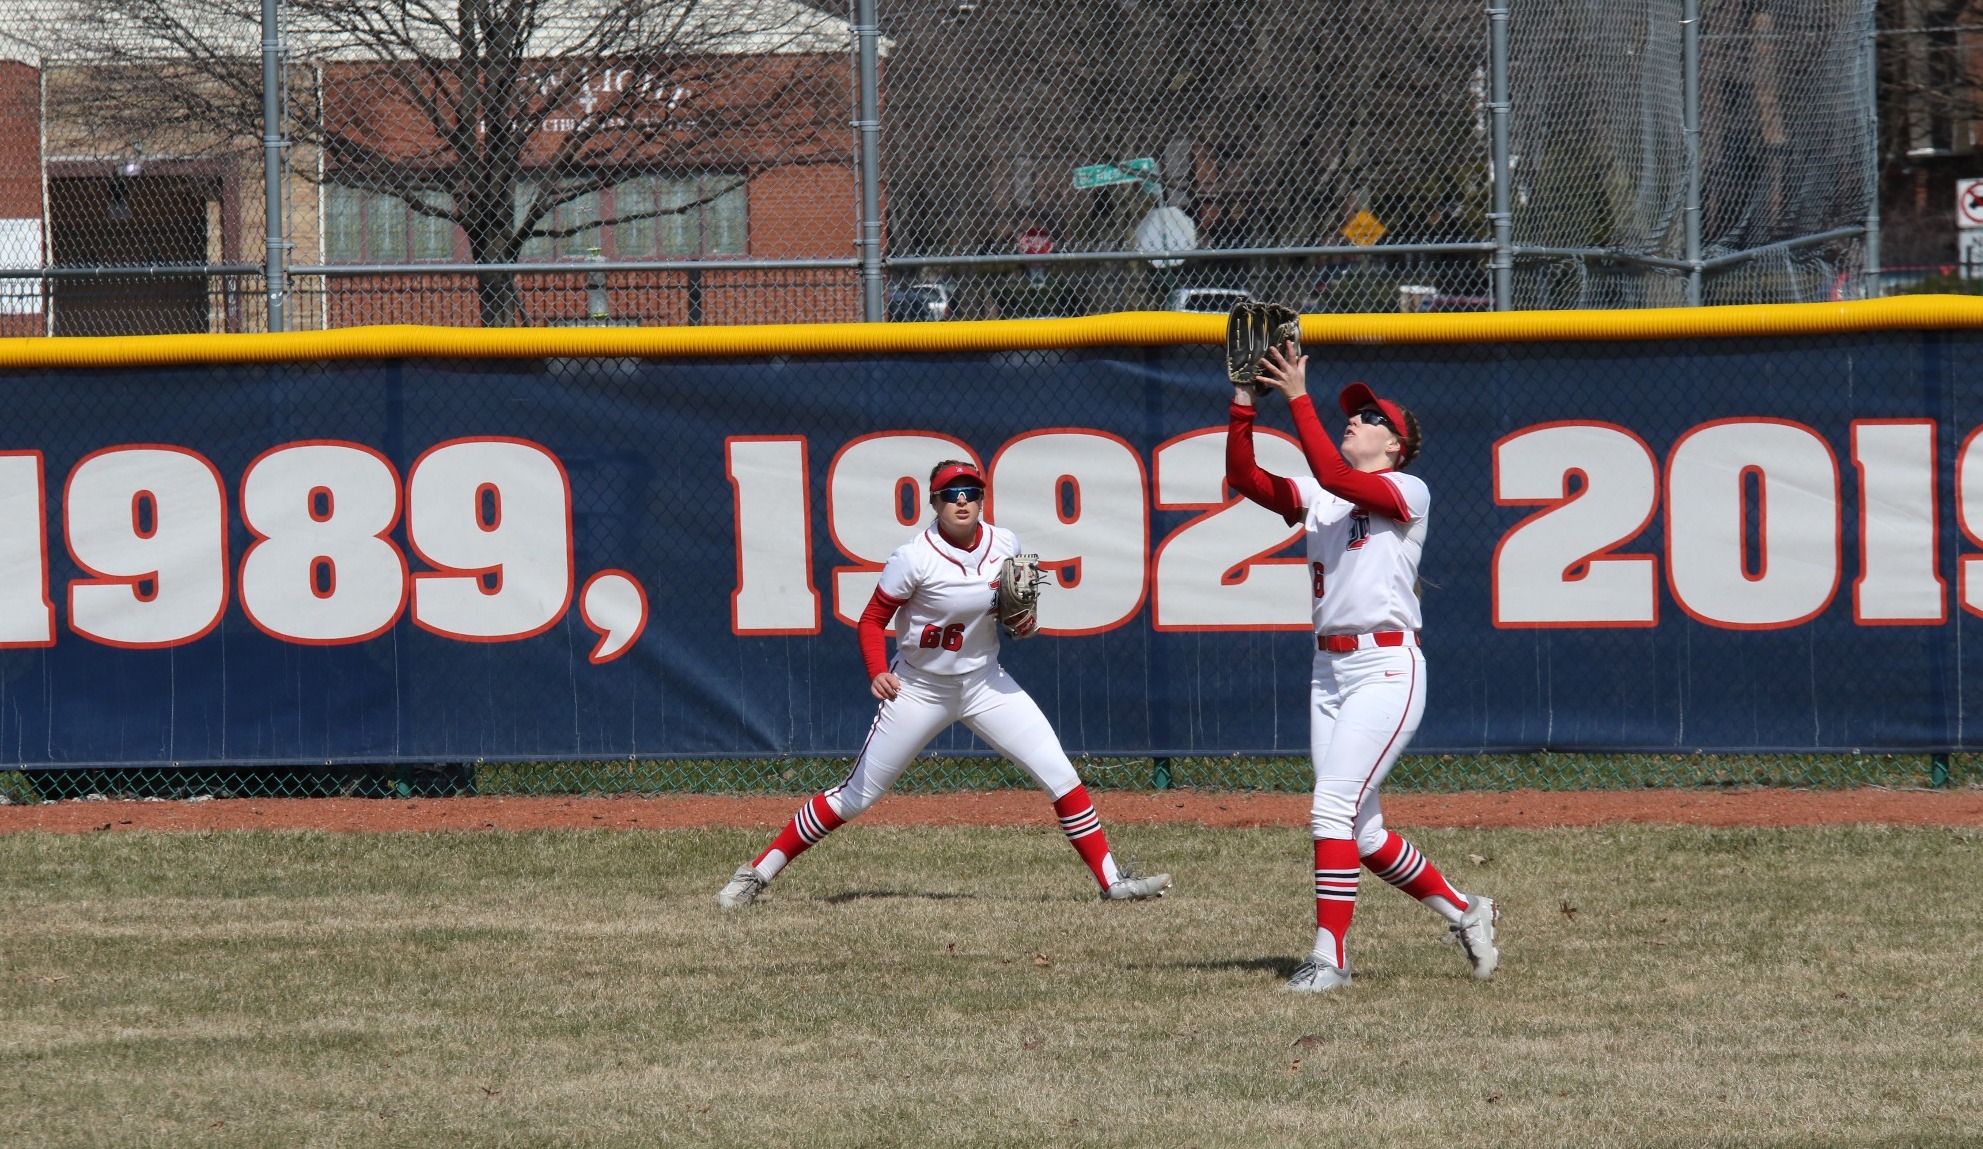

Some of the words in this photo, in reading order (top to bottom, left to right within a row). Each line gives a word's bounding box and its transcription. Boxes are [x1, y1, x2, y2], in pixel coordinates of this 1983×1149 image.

[0, 435, 649, 664] 1989,
[725, 426, 1312, 636] 1992
[1492, 416, 1983, 630] 201
[919, 623, 966, 653] 66
